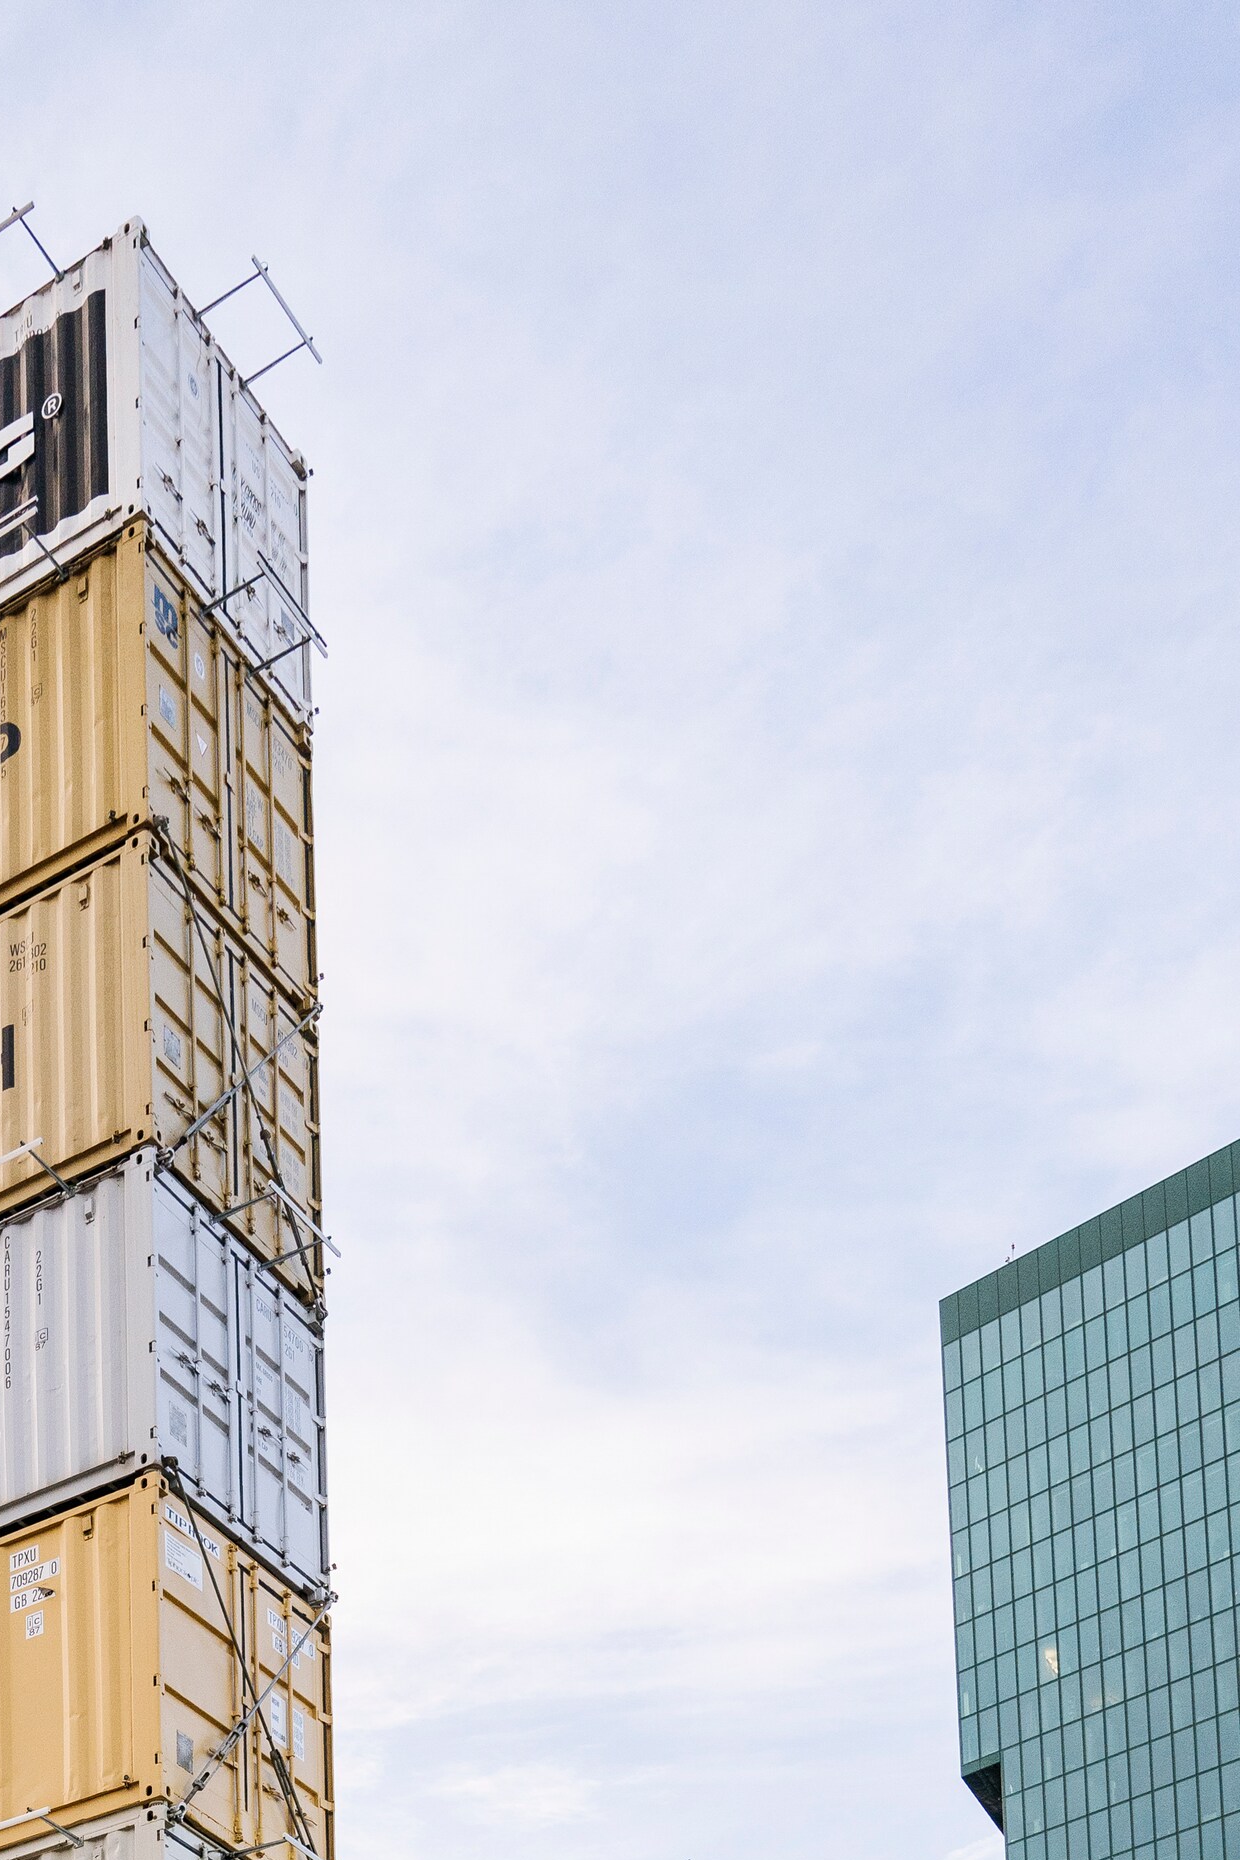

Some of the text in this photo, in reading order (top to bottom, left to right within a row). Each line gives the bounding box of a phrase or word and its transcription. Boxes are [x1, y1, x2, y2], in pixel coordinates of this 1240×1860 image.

[35, 1250, 43, 1305] 22G1
[12, 1548, 37, 1568] TPXU
[11, 1561, 57, 1590] 709287 0
[14, 1594, 27, 1609] GB
